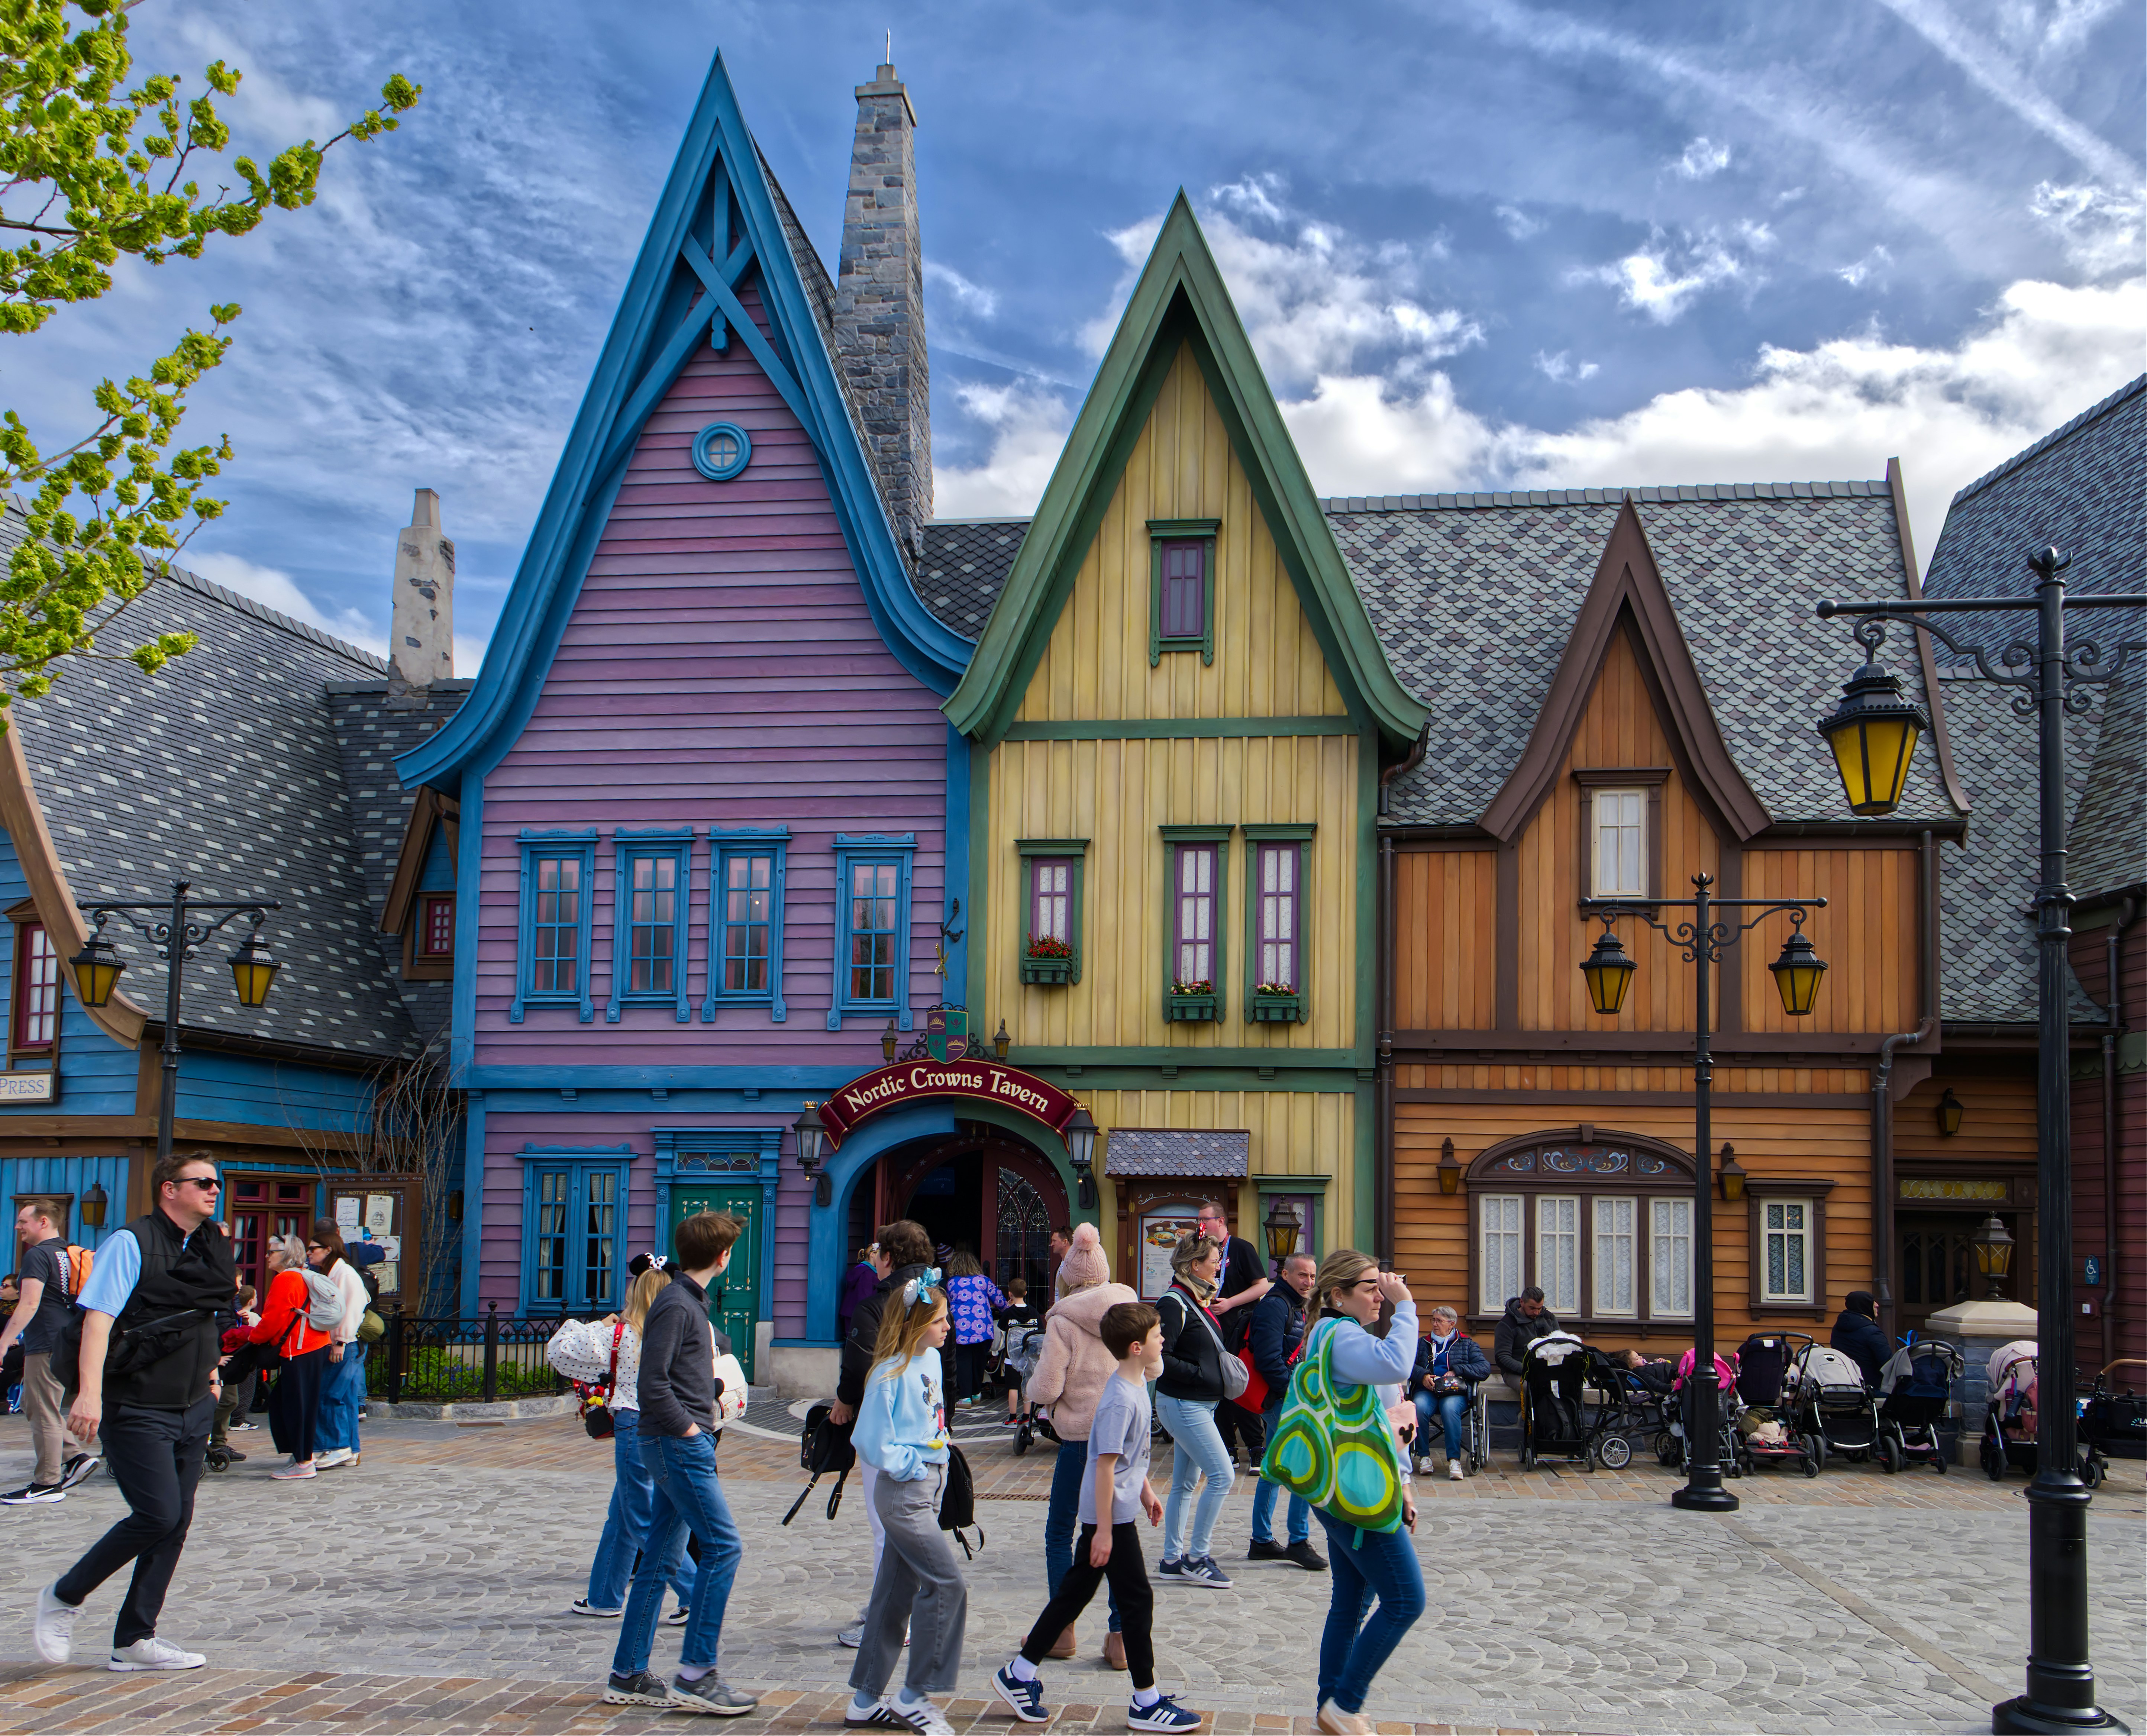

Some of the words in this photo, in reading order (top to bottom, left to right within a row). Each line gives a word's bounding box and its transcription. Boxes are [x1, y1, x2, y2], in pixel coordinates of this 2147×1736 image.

[844, 1075, 906, 1113] Nordic
[910, 1067, 983, 1089] Crowns
[989, 1069, 1049, 1112] Tavern
